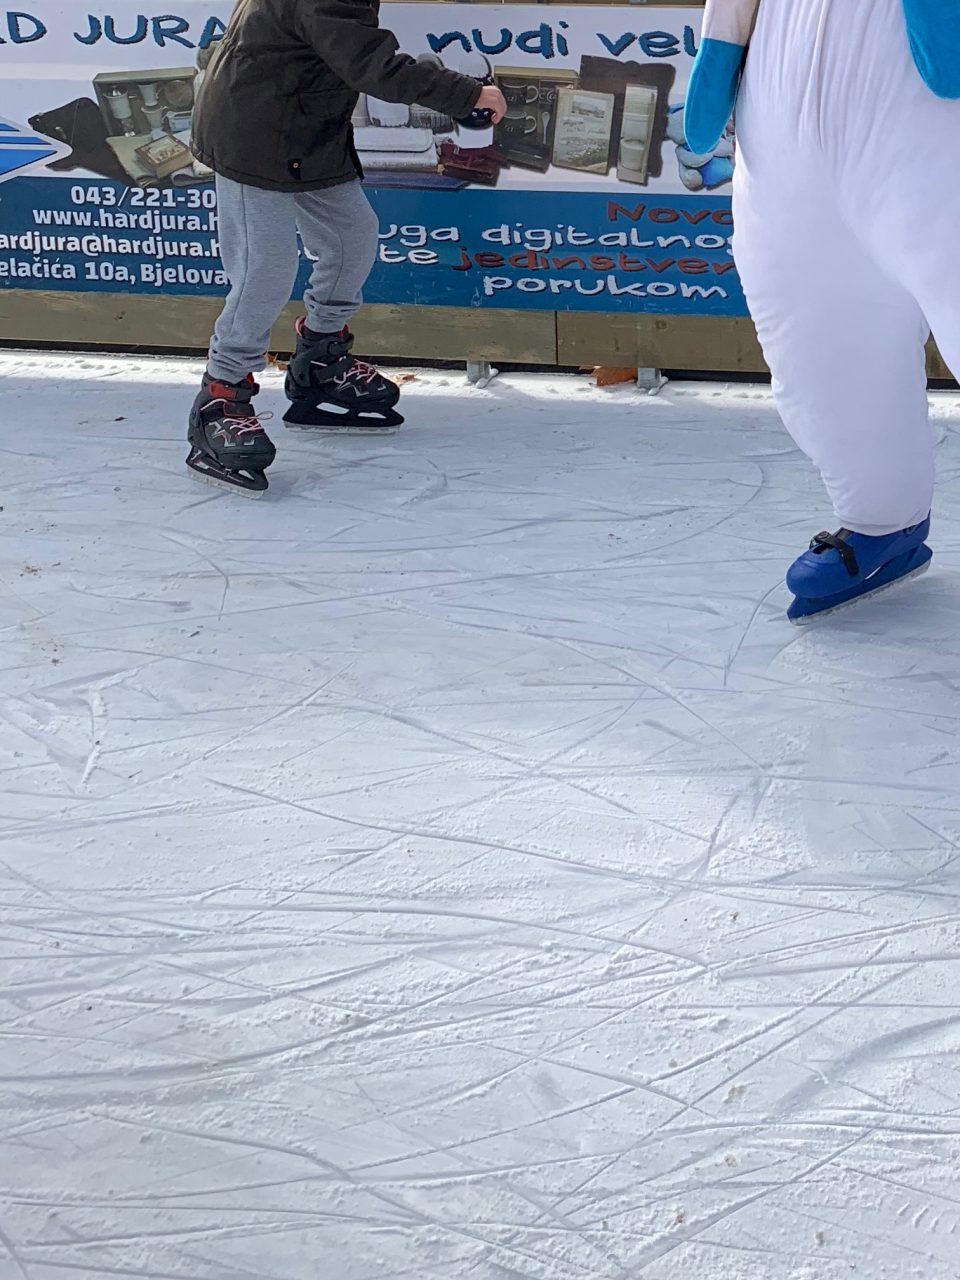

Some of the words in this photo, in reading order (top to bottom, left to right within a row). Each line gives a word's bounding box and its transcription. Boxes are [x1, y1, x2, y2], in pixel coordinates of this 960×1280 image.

[0, 12, 48, 45] D
[73, 14, 227, 50] JURA
[427, 21, 569, 59] nudi
[71, 185, 216, 209] 043/221-30
[85, 261, 136, 285] 10a,
[140, 263, 232, 288] Bjelova
[483, 274, 728, 299] porukom
